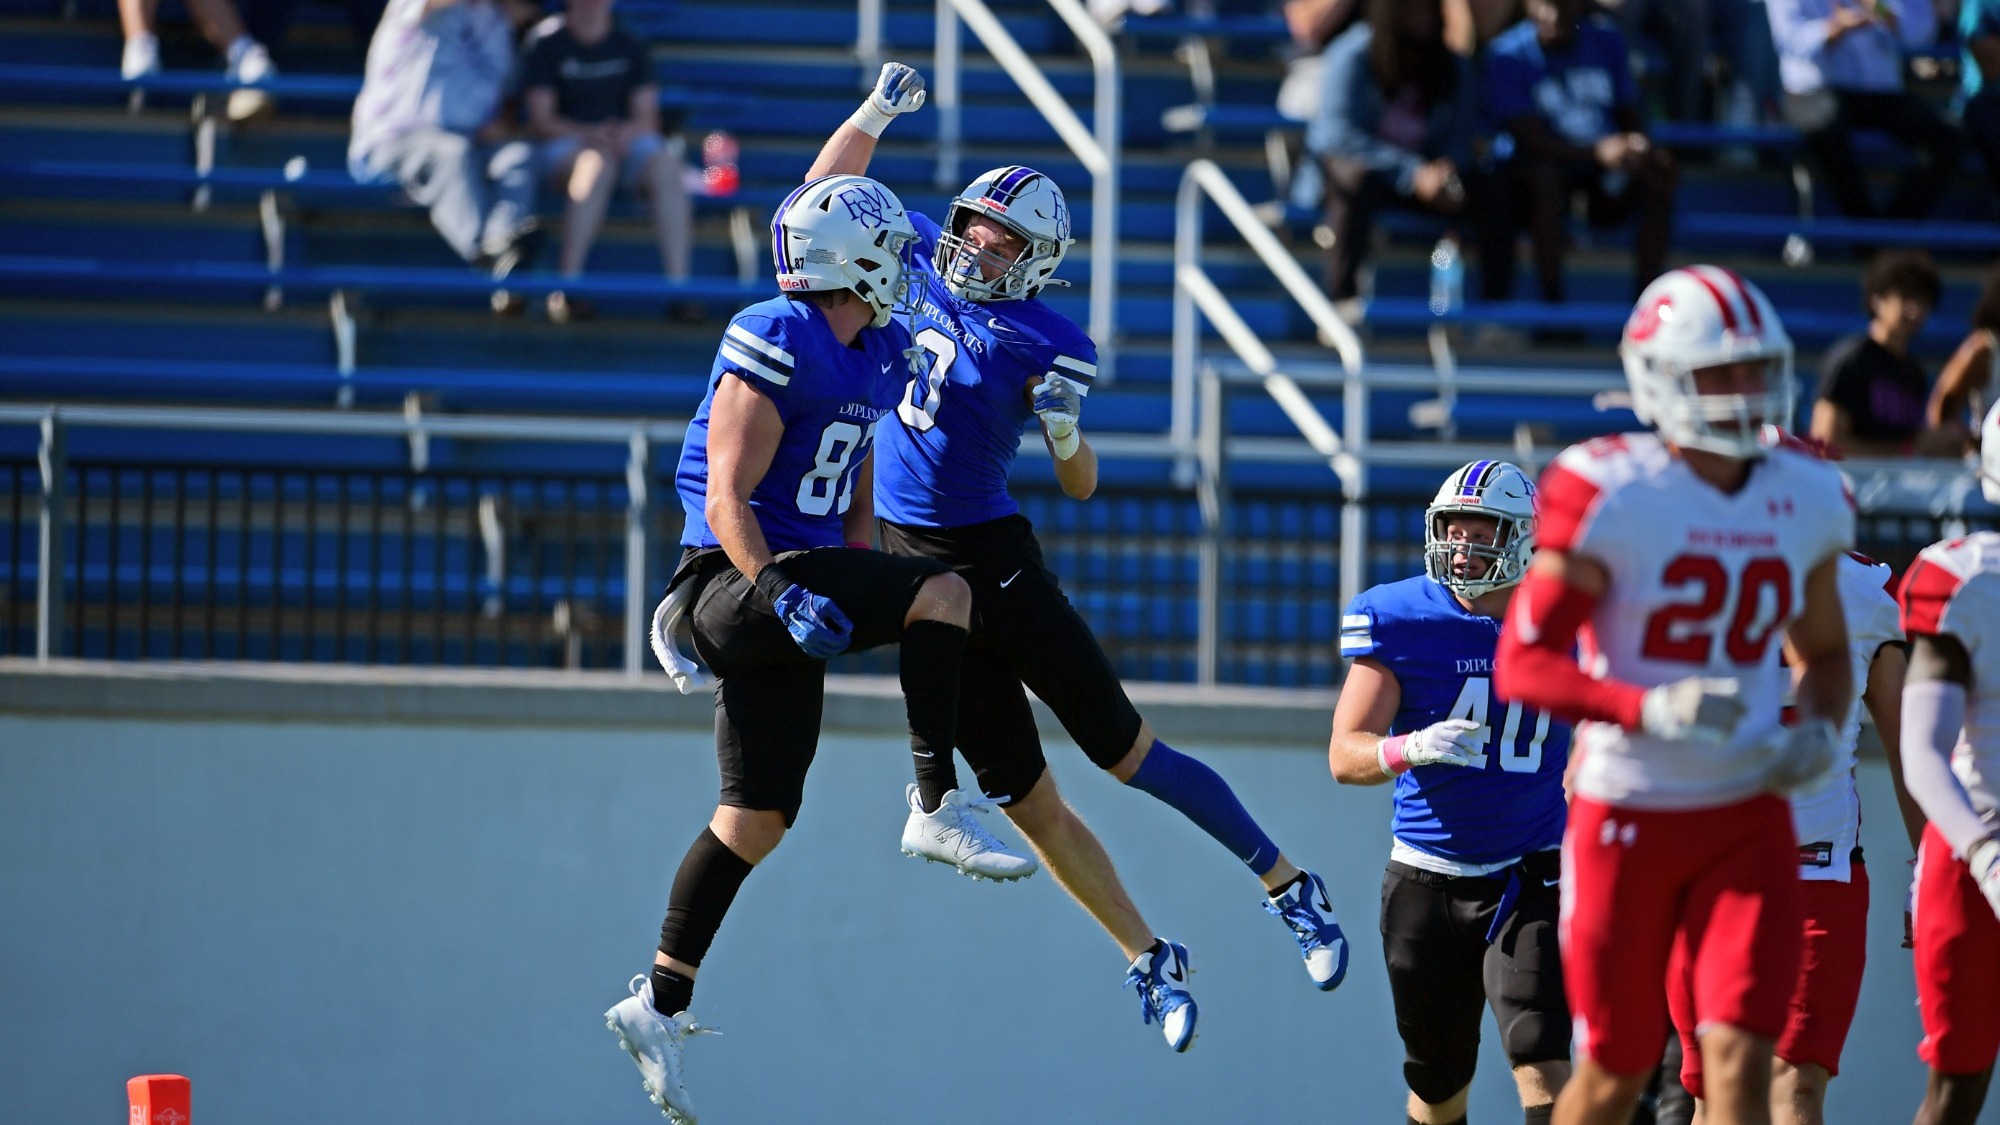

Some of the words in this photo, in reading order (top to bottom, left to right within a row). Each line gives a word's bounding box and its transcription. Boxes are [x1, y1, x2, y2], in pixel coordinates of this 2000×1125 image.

[980, 196, 1007, 213] Riddell
[794, 257, 804, 270] 87
[1641, 554, 1793, 665] 20
[1447, 677, 1551, 774] 40
